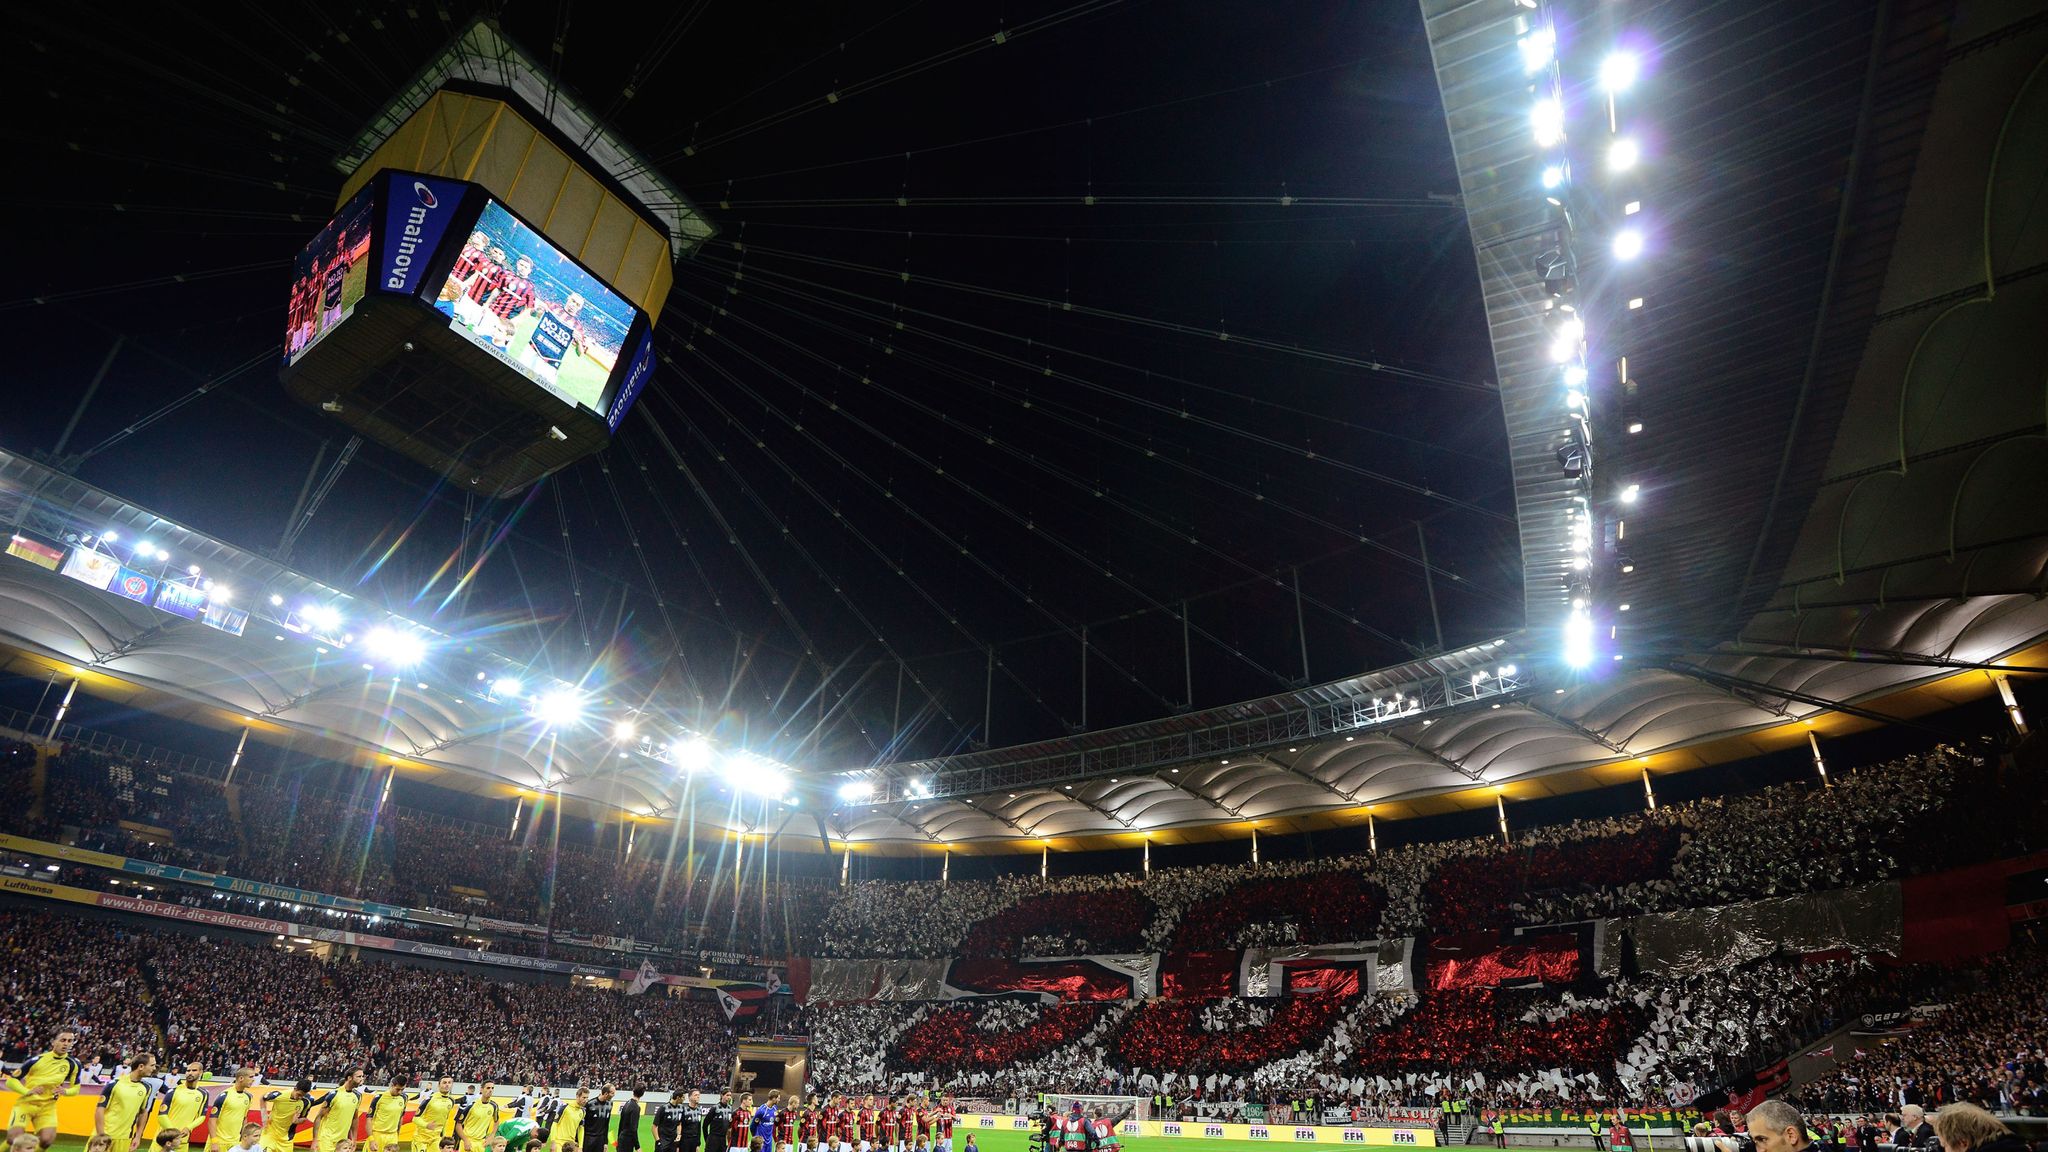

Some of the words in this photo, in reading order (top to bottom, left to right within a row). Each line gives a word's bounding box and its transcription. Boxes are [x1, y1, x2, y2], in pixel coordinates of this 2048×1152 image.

[388, 207, 427, 289] mainova
[542, 316, 558, 330] NO
[558, 327, 571, 341] TO
[474, 337, 525, 374] COMMERZBANK
[536, 377, 558, 394] ARENA
[608, 361, 642, 428] mainova
[4, 879, 54, 895] Lufthansa
[229, 879, 254, 894] Alle
[258, 884, 296, 901] fahren
[102, 896, 283, 932] www.hol-dir-die-adlercard.de
[420, 945, 452, 956] mainova
[708, 950, 746, 960] COMMANDO
[467, 951, 479, 960] Mit
[481, 953, 509, 964] Energie
[533, 959, 558, 971] Region
[711, 957, 741, 966] GIESSEN
[578, 966, 606, 975] mainova
[1014, 1120, 1028, 1128] FFH
[1164, 1126, 1181, 1134] FFH
[1205, 1127, 1223, 1136] FFH
[1250, 1129, 1268, 1138] FFH
[1295, 1130, 1315, 1139] FFH
[1344, 1132, 1364, 1141] FFH
[1394, 1133, 1414, 1142] FFH
